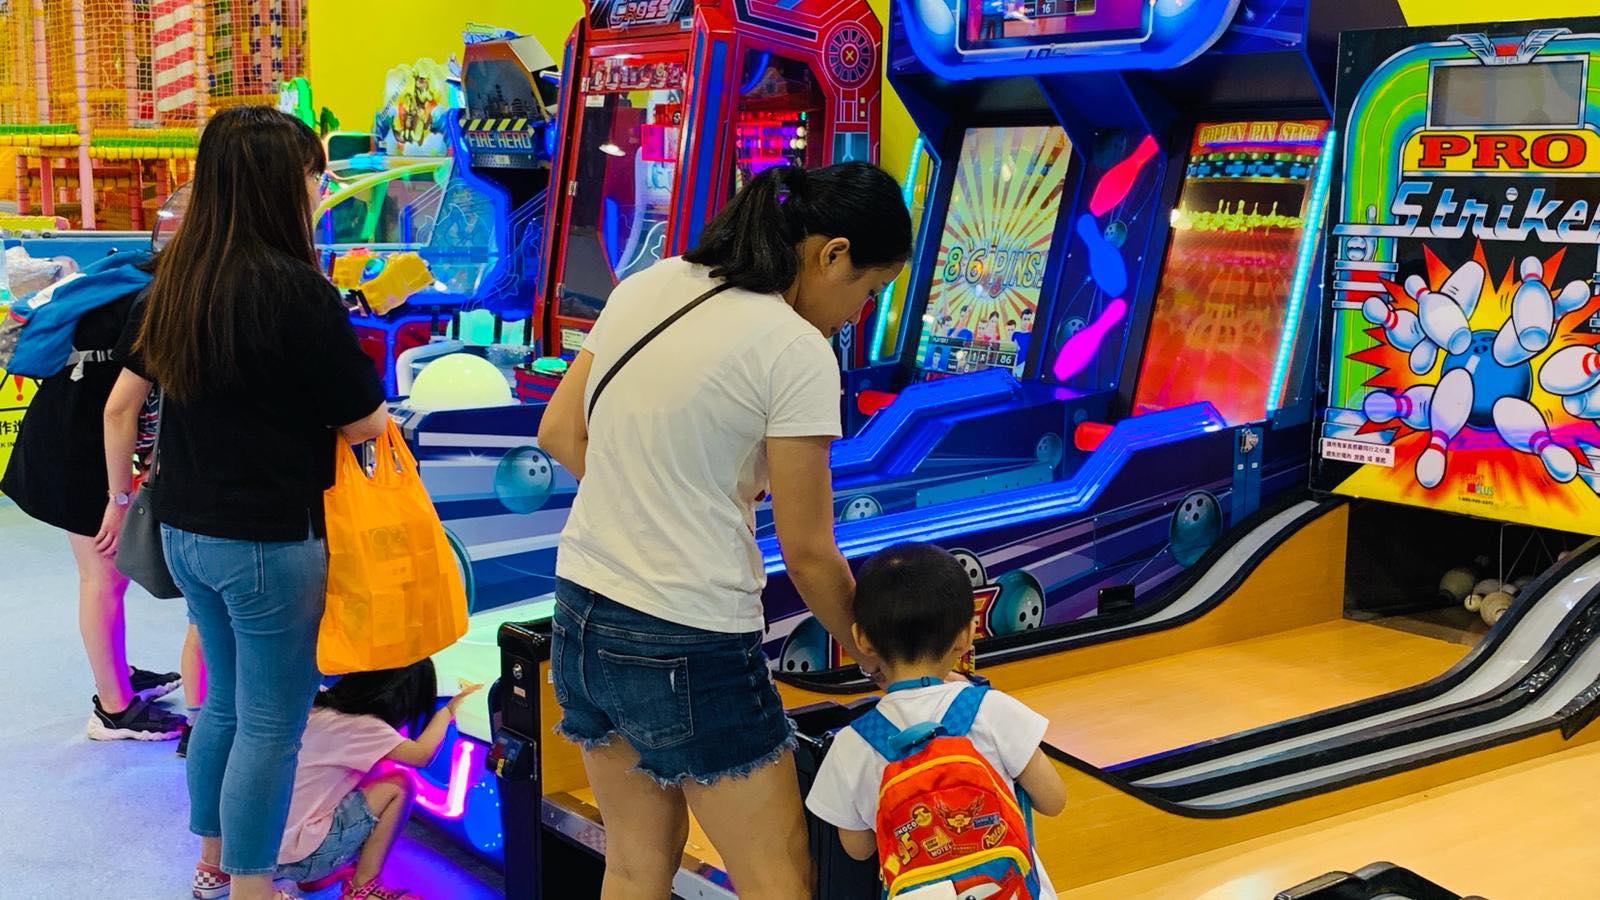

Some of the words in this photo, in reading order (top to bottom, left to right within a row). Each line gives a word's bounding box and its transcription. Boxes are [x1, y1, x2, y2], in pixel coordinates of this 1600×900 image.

[1041, 3, 1051, 14] 16
[467, 131, 496, 148] FIRE
[495, 131, 532, 149] HERO
[1248, 122, 1278, 142] PIN
[1418, 133, 1587, 169] PRO
[1000, 354, 1012, 364] 86
